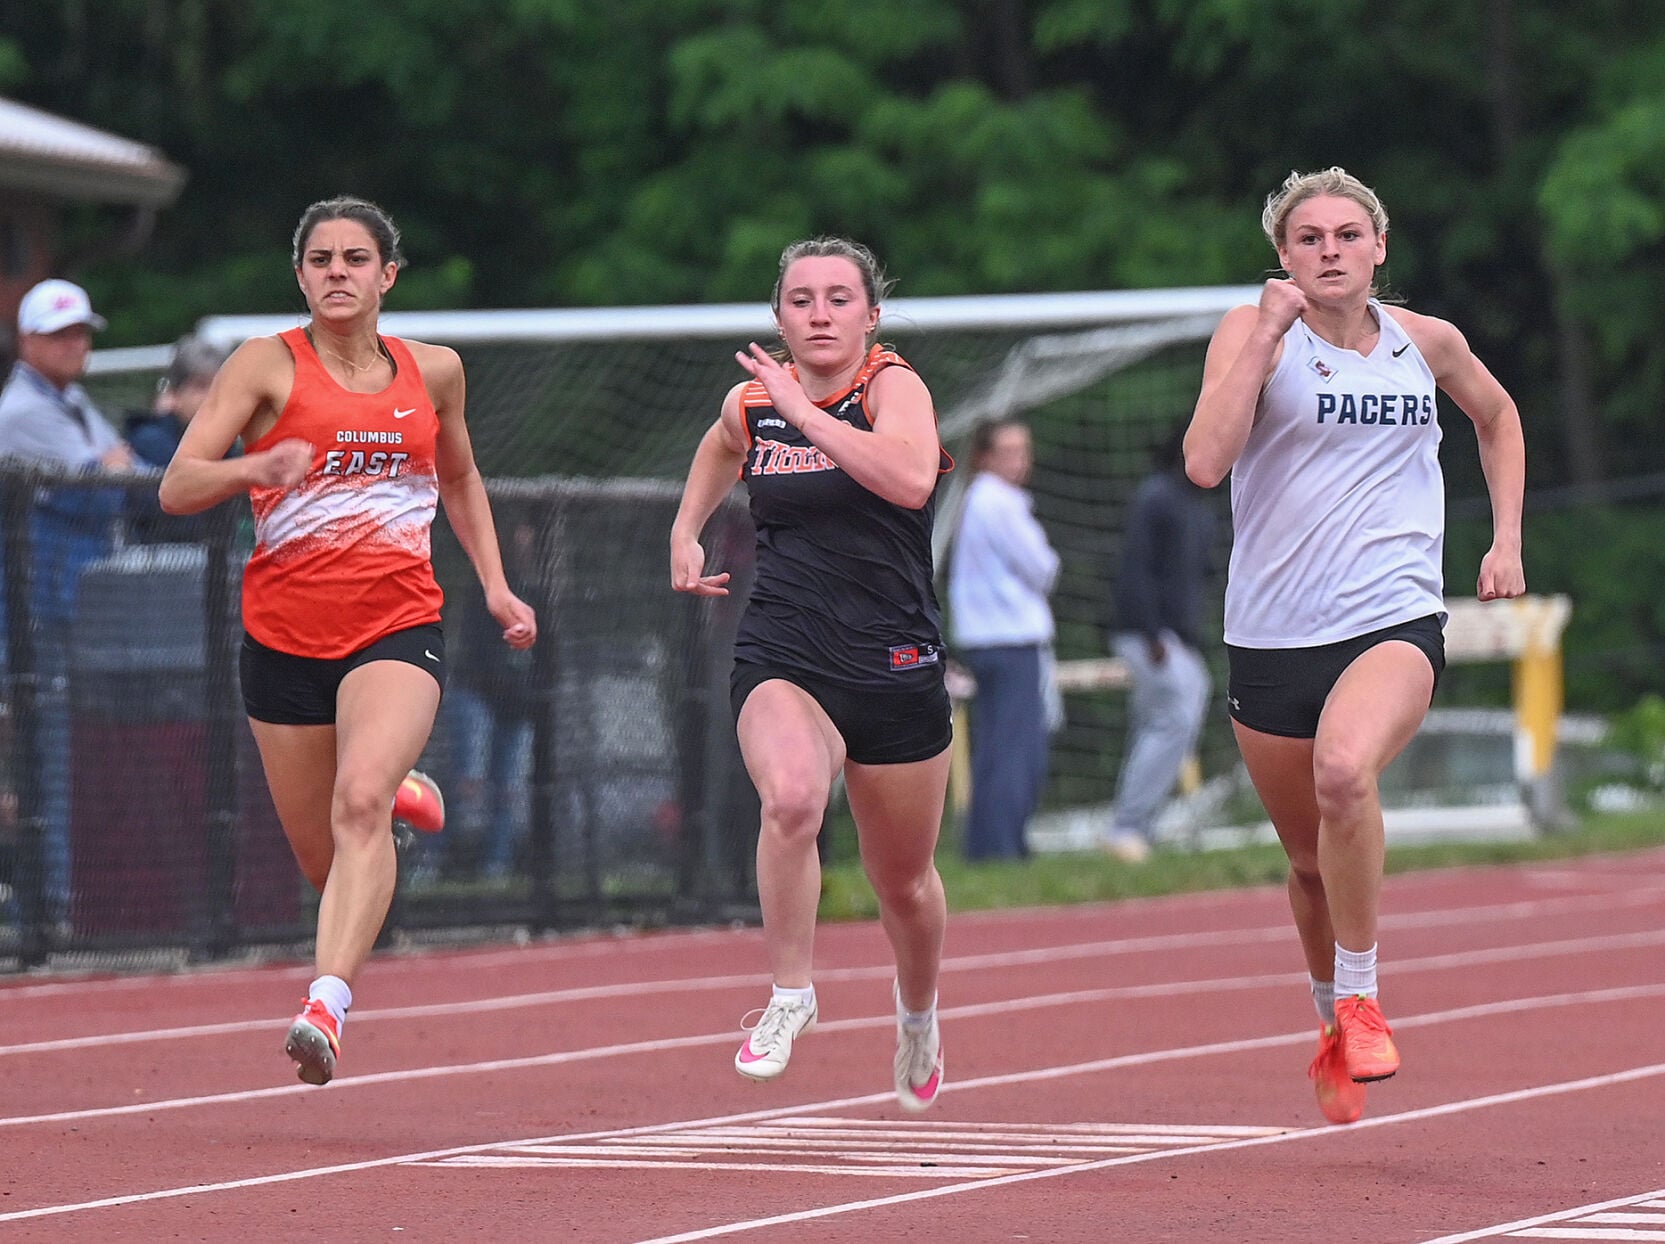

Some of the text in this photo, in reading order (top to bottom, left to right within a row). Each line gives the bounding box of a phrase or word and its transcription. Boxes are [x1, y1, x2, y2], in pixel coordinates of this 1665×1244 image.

[1316, 393, 1432, 425] PACERS
[336, 430, 403, 444] COLUMBUS
[322, 450, 409, 478] EAST
